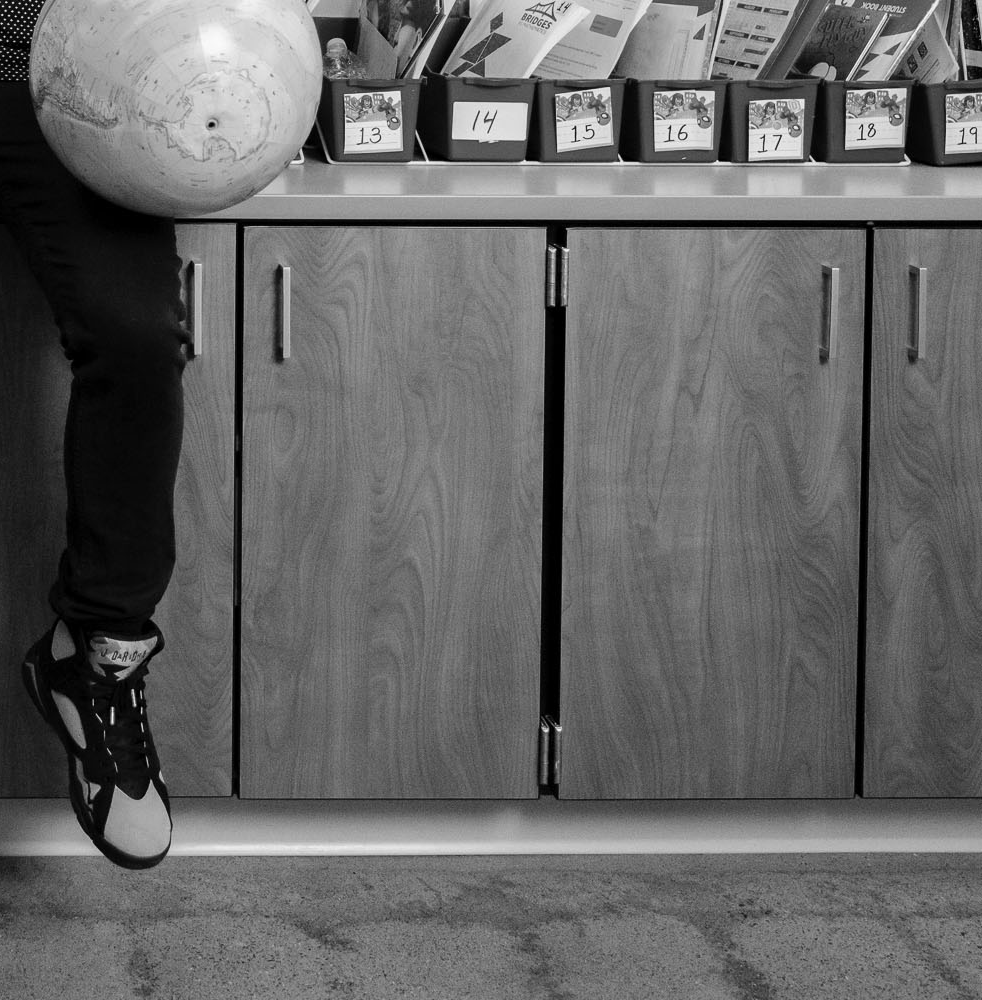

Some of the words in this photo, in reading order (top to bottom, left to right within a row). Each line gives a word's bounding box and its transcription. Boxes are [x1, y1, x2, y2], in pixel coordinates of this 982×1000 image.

[556, 0, 572, 14] 14
[861, 1, 880, 11] BOOK
[879, 4, 907, 14] STUDENT
[520, 12, 553, 31] BRIDGES
[471, 109, 498, 134] 14
[356, 126, 383, 146] 13
[570, 124, 596, 143] 15
[663, 124, 689, 143] 16
[856, 122, 877, 141] 18
[958, 126, 978, 146] 19
[757, 133, 783, 154] 17
